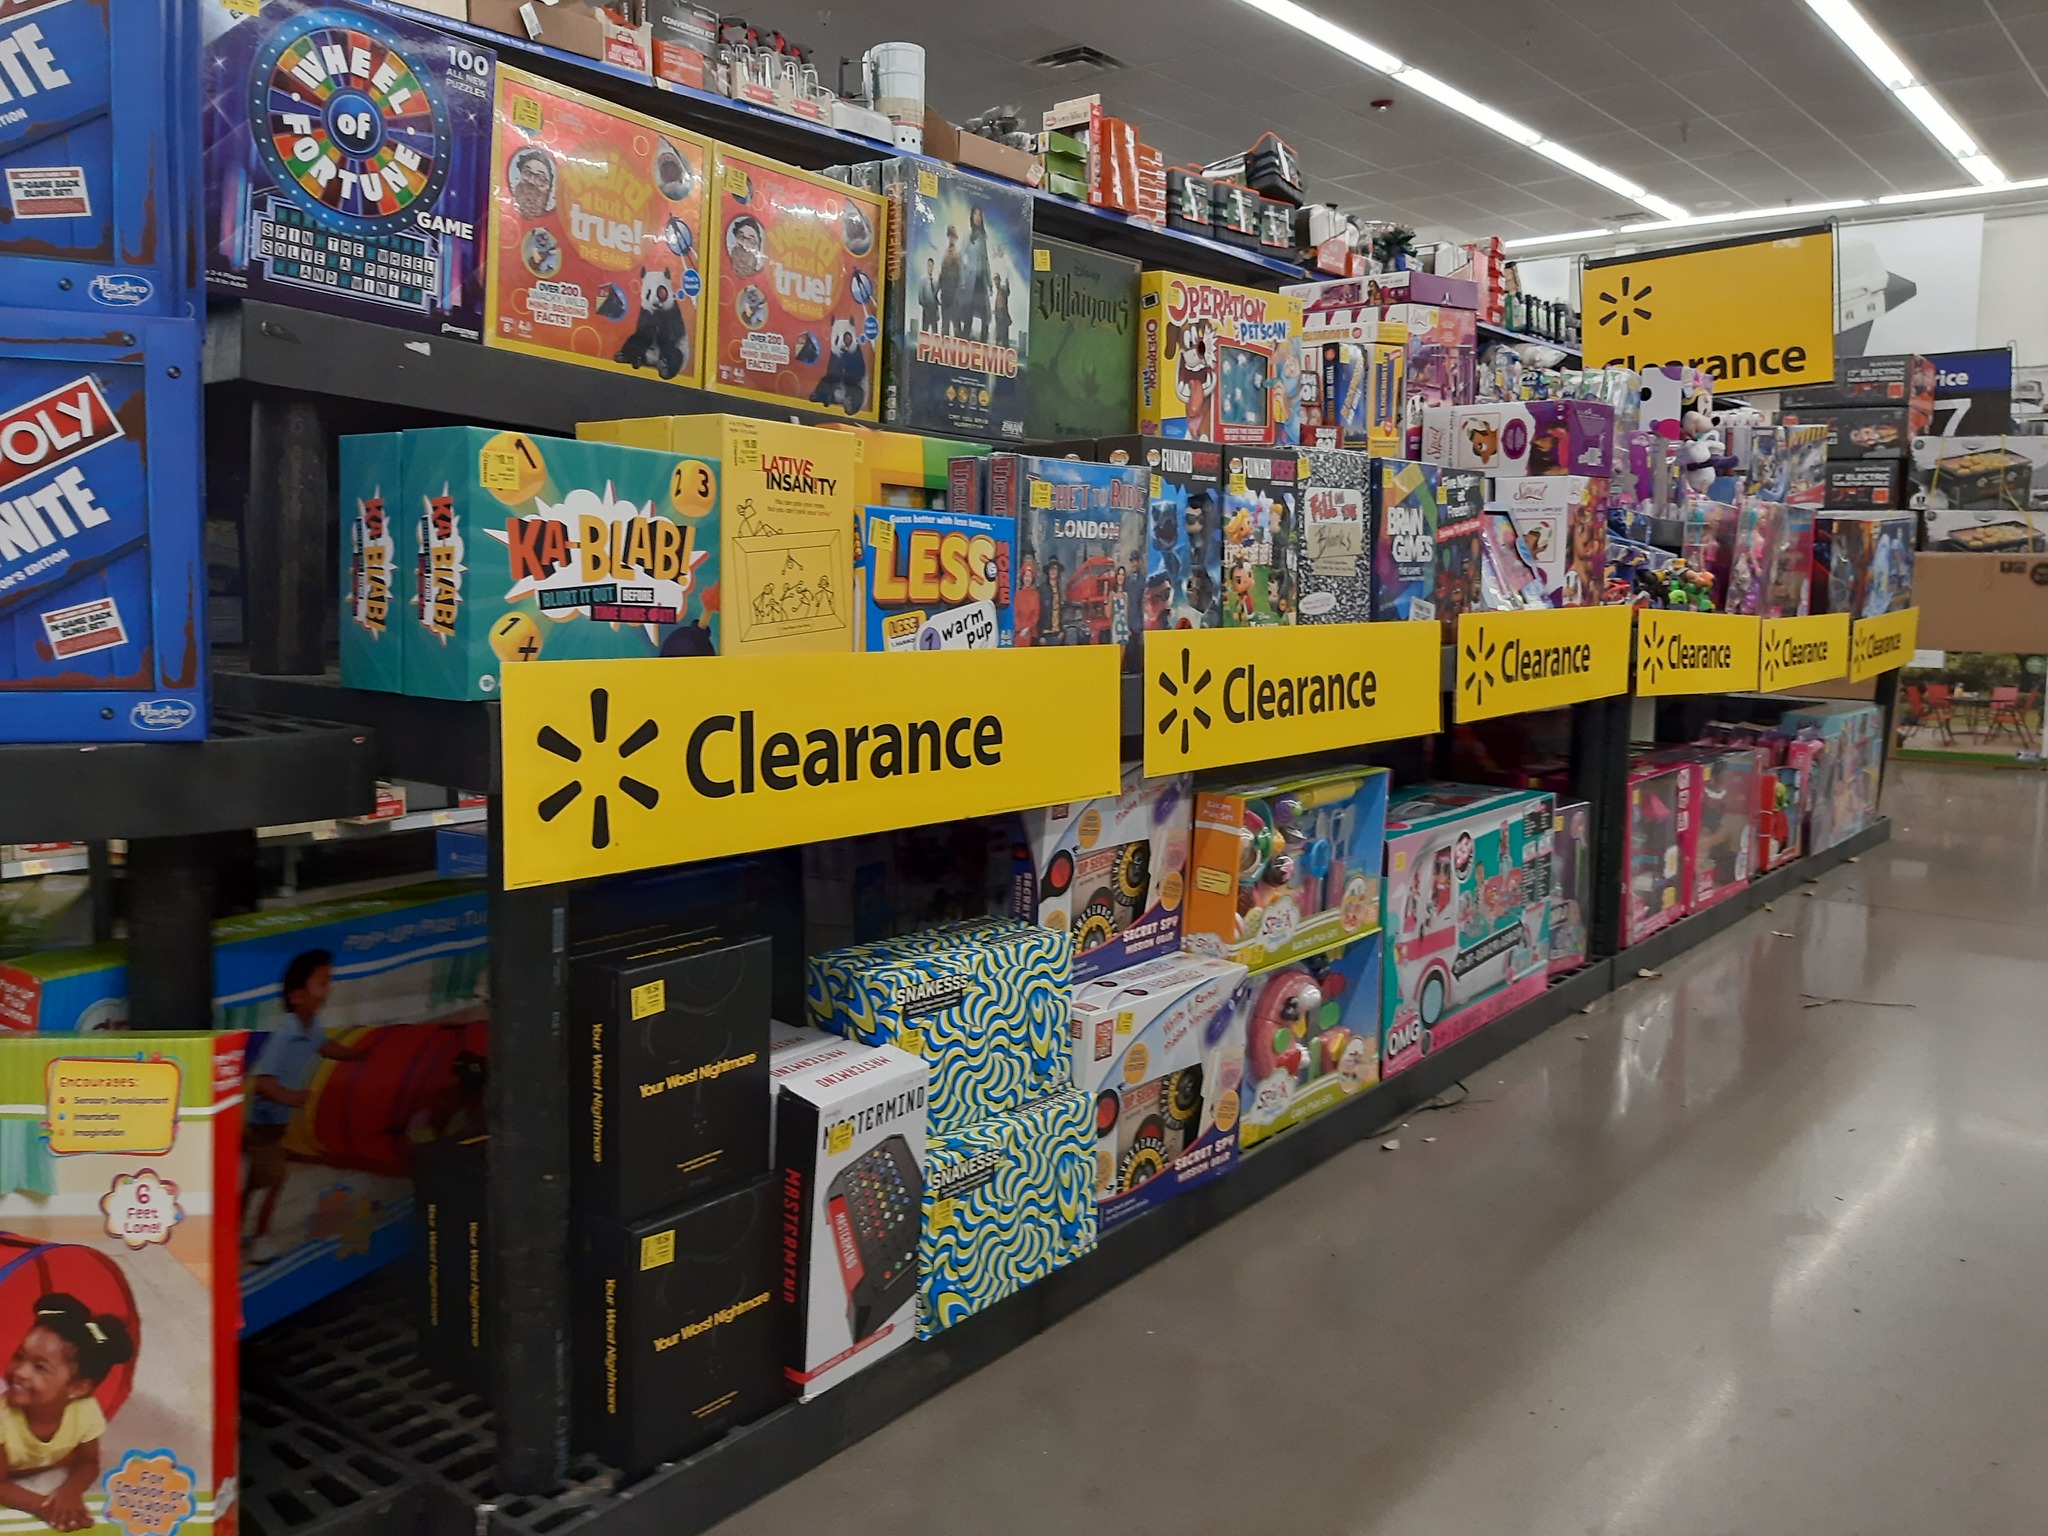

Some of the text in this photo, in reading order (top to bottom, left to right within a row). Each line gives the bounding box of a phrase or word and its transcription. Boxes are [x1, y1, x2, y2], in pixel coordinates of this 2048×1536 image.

[446, 46, 489, 76] 100
[291, 45, 411, 114] WHEEL
[446, 68, 488, 88] ALL NEW
[446, 78, 486, 98] PUZZLES
[283, 114, 421, 201] FORTUNE
[417, 212, 474, 239] GAME
[570, 204, 643, 255] true!
[887, 182, 904, 282] PANDEMIC
[262, 221, 434, 274] SPIN THE WHEEL
[580, 245, 631, 269] THE GAME
[261, 240, 434, 289] SOLVE A PUZZLE
[300, 264, 338, 285] AND
[539, 283, 579, 297] OVER 200
[775, 262, 832, 306] true!
[536, 311, 572, 326] FACTS!
[1034, 273, 1129, 336] Villainous
[1168, 280, 1267, 327] OPERATION
[750, 334, 783, 346] OVER 200
[916, 330, 1019, 379] PANDEMIC
[1146, 319, 1158, 389] OPERATION
[748, 360, 776, 371] FACTS!
[1935, 369, 1970, 386] rice
[0, 392, 93, 466] OLY
[761, 454, 813, 478] LATIVE
[1161, 449, 1193, 473] FUNKO
[1243, 457, 1271, 479] FUNKO
[699, 469, 709, 498] 3
[1110, 478, 1147, 513] RIDE
[889, 514, 911, 524] Guess
[913, 514, 935, 524] better
[937, 516, 953, 525] with
[954, 517, 967, 526] less
[1054, 518, 1120, 540] LONDON
[1387, 506, 1423, 535] BRAIN
[24, 548, 70, 577] EDITION
[505, 514, 697, 587] KA-BLAB!
[1392, 535, 1433, 563] GAMES
[874, 530, 998, 606] LESS
[542, 589, 578, 607] BLURT
[580, 588, 591, 604] IT
[592, 586, 614, 603] OUT
[889, 616, 919, 638] LESS
[941, 610, 984, 641] warm
[967, 621, 993, 649] pup
[1668, 634, 1731, 669] Clearance
[1782, 637, 1828, 667] Clearance
[1866, 632, 1901, 658] Clearance
[1501, 640, 1590, 683] Clearance
[1223, 664, 1377, 724] Clearance
[685, 710, 1003, 799] Clearance
[896, 974, 969, 1005] SNAKESSS
[1388, 1019, 1420, 1056] OMG
[59, 1076, 139, 1088] Encourages:
[639, 1052, 758, 1098] Your Worst Nightmare
[815, 1056, 891, 1088] MASTERMIND
[74, 1096, 169, 1106] Sensory Development
[590, 1024, 604, 1163] Your Worst Nightmare
[74, 1112, 120, 1122] Interaction
[823, 1085, 925, 1150] MTERMIND
[74, 1128, 125, 1138] Imagination
[932, 1150, 1000, 1190] SNAKESSS
[135, 1184, 151, 1204] 6
[126, 1208, 159, 1219] Feet
[783, 1168, 801, 1304] MASTERMIND
[835, 1212, 859, 1269] MASTERMIND
[654, 1292, 771, 1352] Your Worst Nightmare
[604, 1279, 617, 1414] Your Worst Nightmare
[115, 1481, 164, 1498] Indoor
[141, 1471, 164, 1484] For
[118, 1495, 177, 1514] Outdoor
